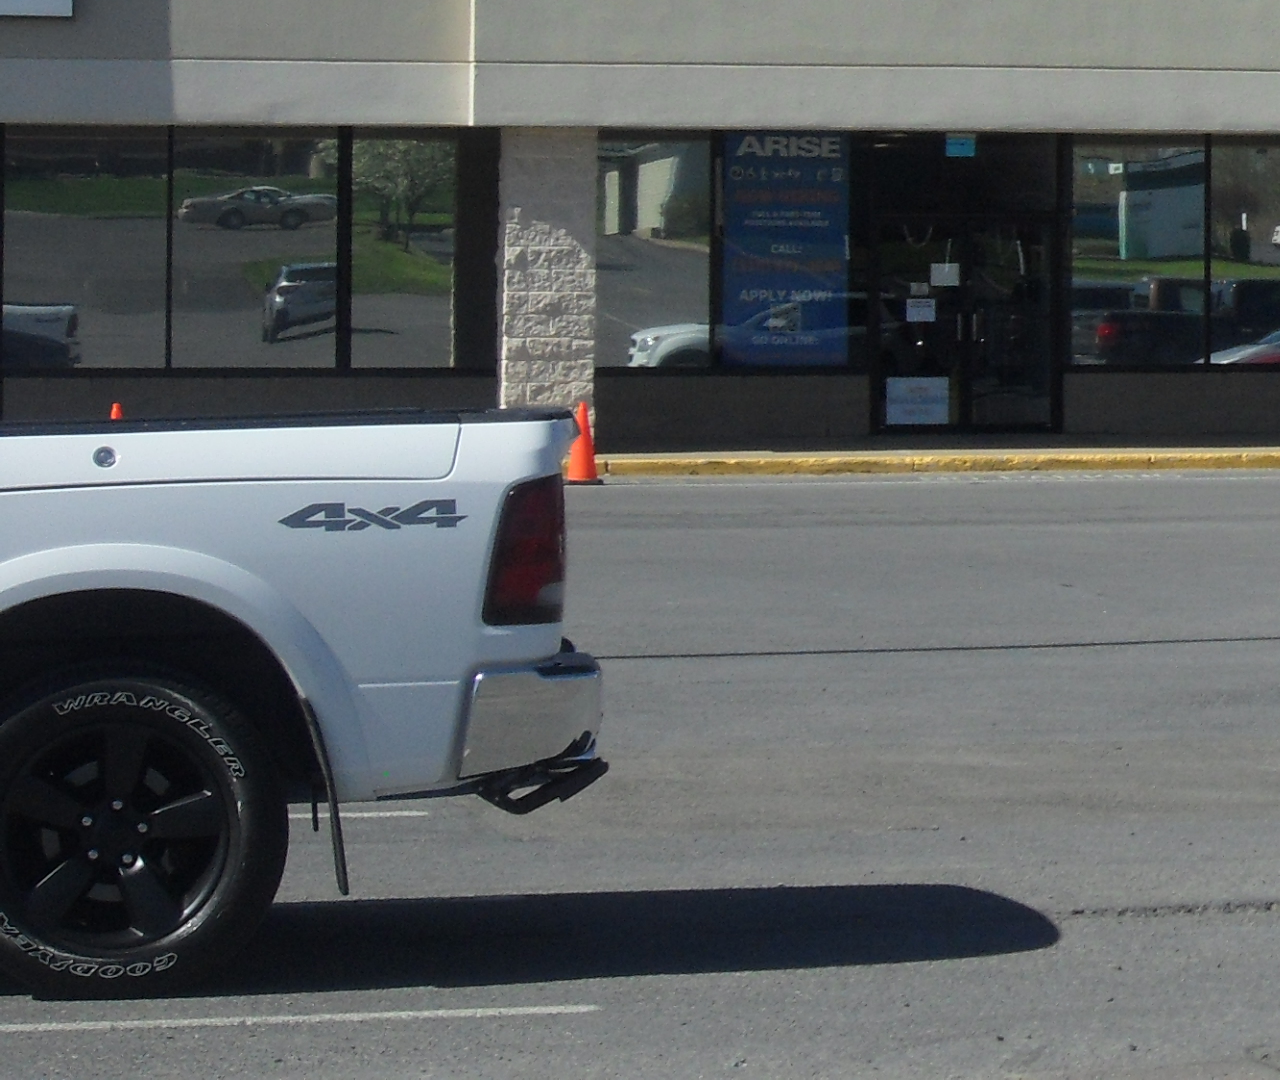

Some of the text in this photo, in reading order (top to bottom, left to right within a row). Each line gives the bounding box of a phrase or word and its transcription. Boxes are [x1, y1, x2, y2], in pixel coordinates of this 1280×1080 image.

[735, 135, 841, 158] ARISE
[739, 289, 787, 302] APPLY
[52, 691, 246, 778] WRANGLER
